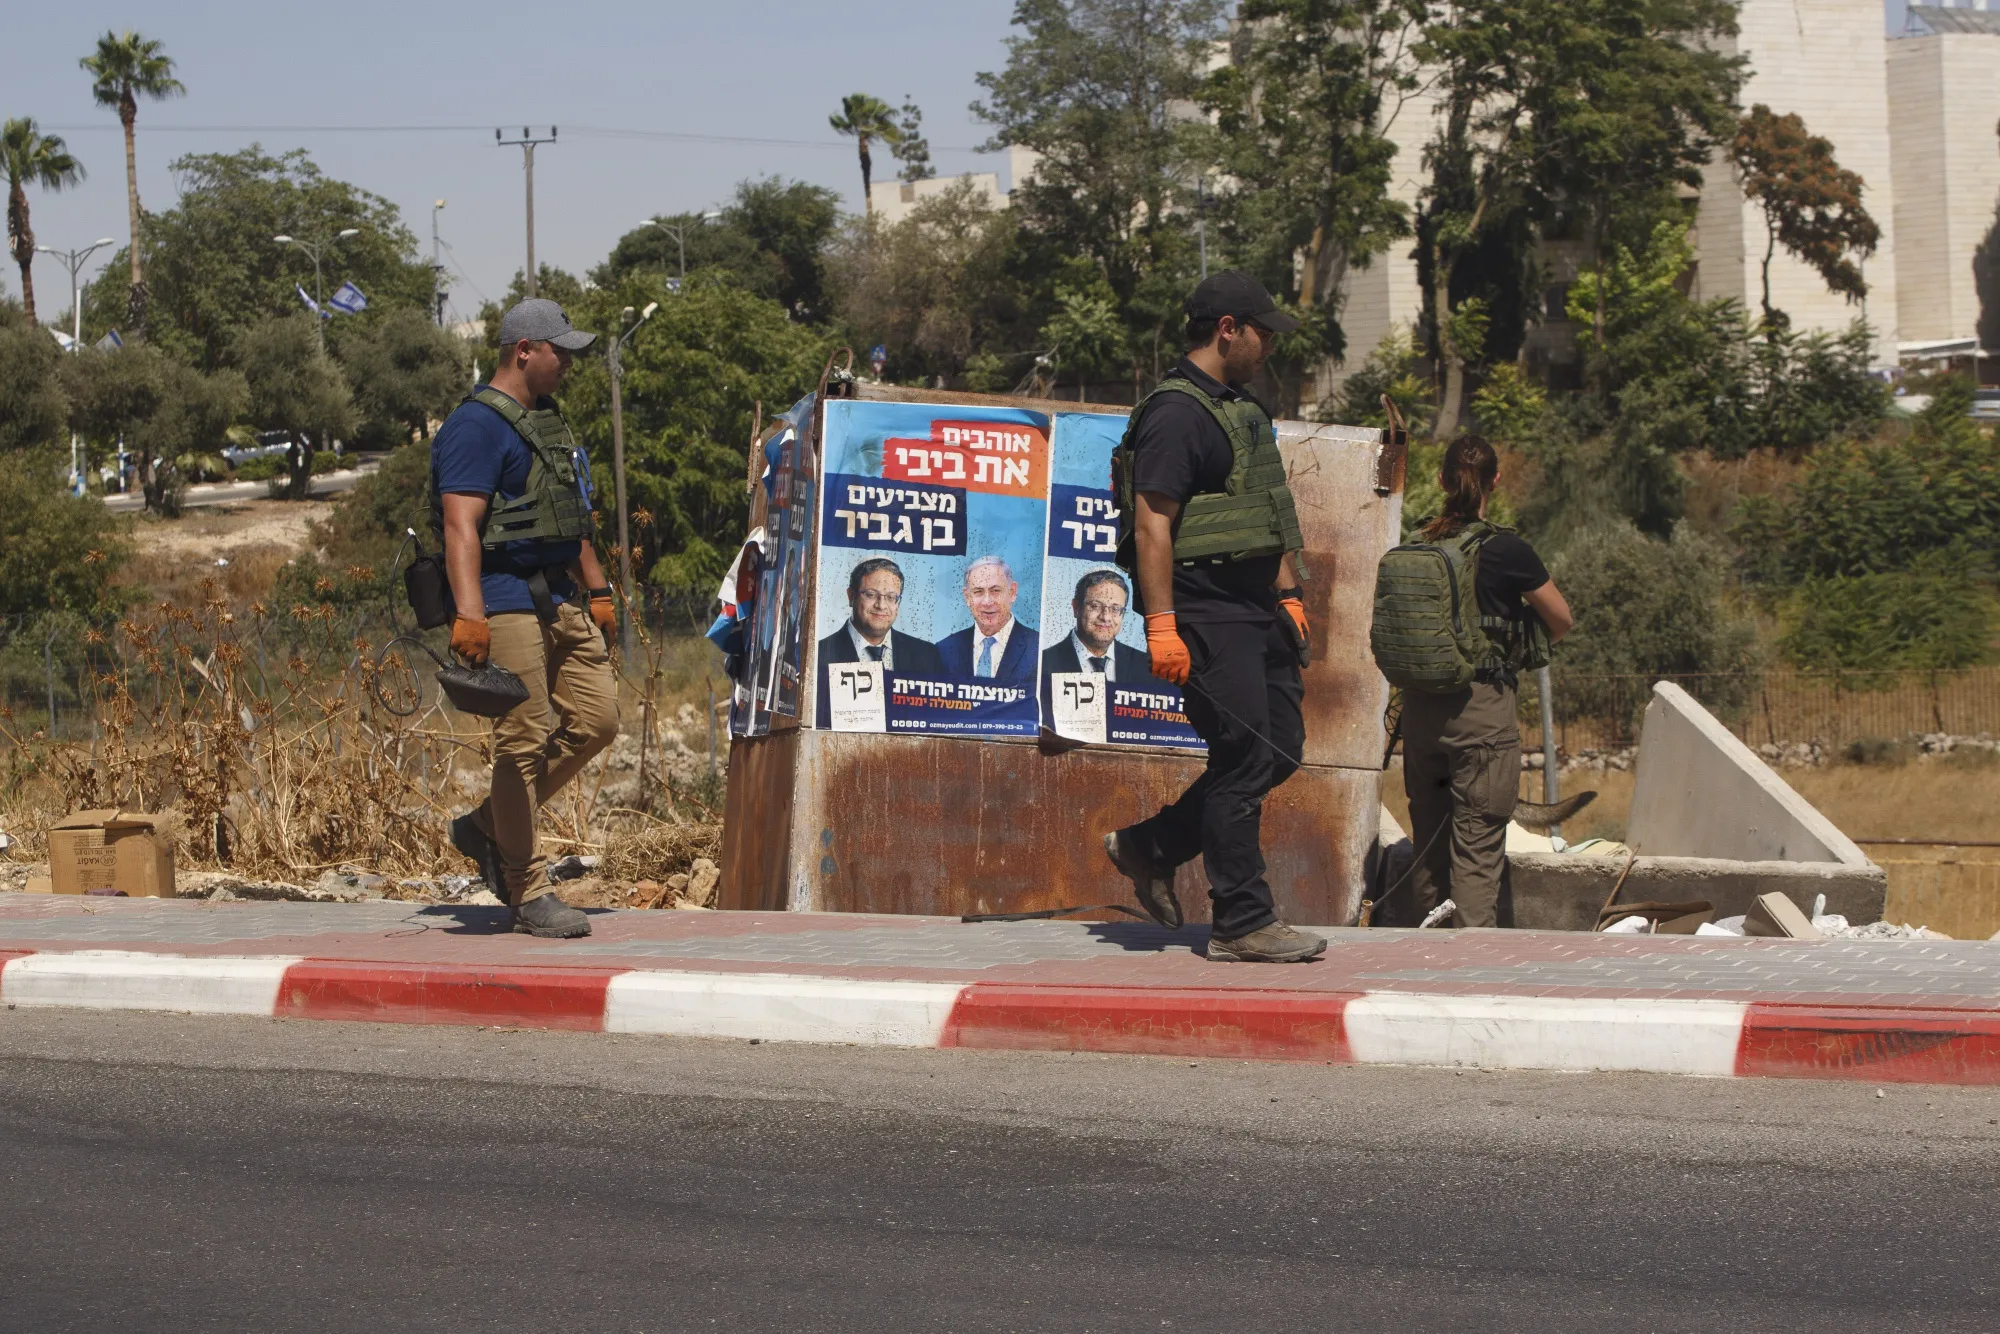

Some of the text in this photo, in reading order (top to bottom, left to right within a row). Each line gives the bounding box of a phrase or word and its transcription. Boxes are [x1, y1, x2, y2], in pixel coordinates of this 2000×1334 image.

[942, 427, 1031, 453] אוהבים
[895, 447, 1030, 486] את ביבי
[847, 484, 957, 514] מצביעים
[834, 509, 914, 544] גביר
[920, 517, 956, 551] בן
[1061, 520, 1118, 552] ביר
[840, 669, 873, 701] כף
[892, 678, 954, 698] יהודית
[958, 684, 1018, 703] עוצמה
[1063, 680, 1095, 711] כף
[929, 696, 972, 711] ממשלה
[1113, 689, 1175, 711] יהודית
[1113, 706, 1149, 719] ימנית!
[929, 722, 978, 730] ozmayeudit.com
